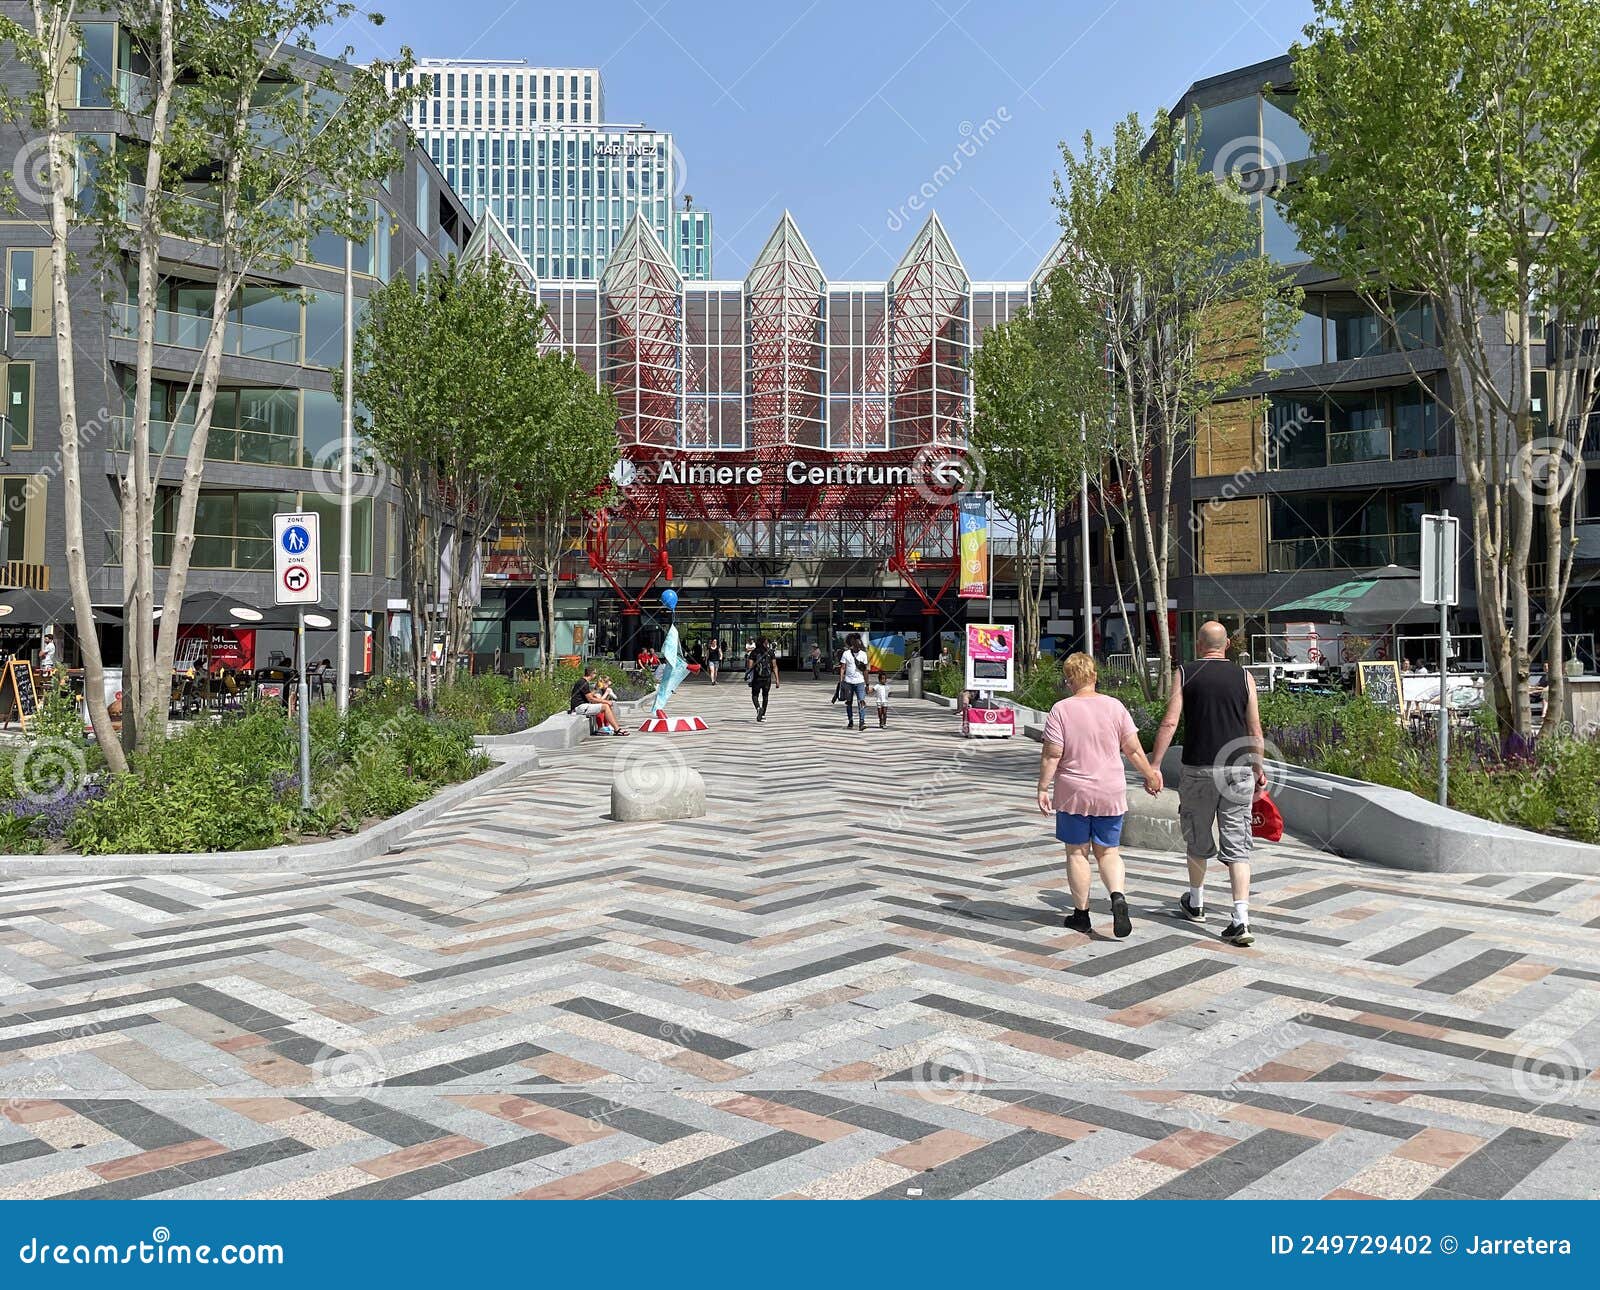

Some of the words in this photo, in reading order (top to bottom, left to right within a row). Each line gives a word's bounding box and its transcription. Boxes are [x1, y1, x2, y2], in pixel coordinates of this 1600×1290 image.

[594, 144, 656, 155] MARTINEZ
[656, 460, 763, 484] Almere
[786, 460, 913, 485] Centrum
